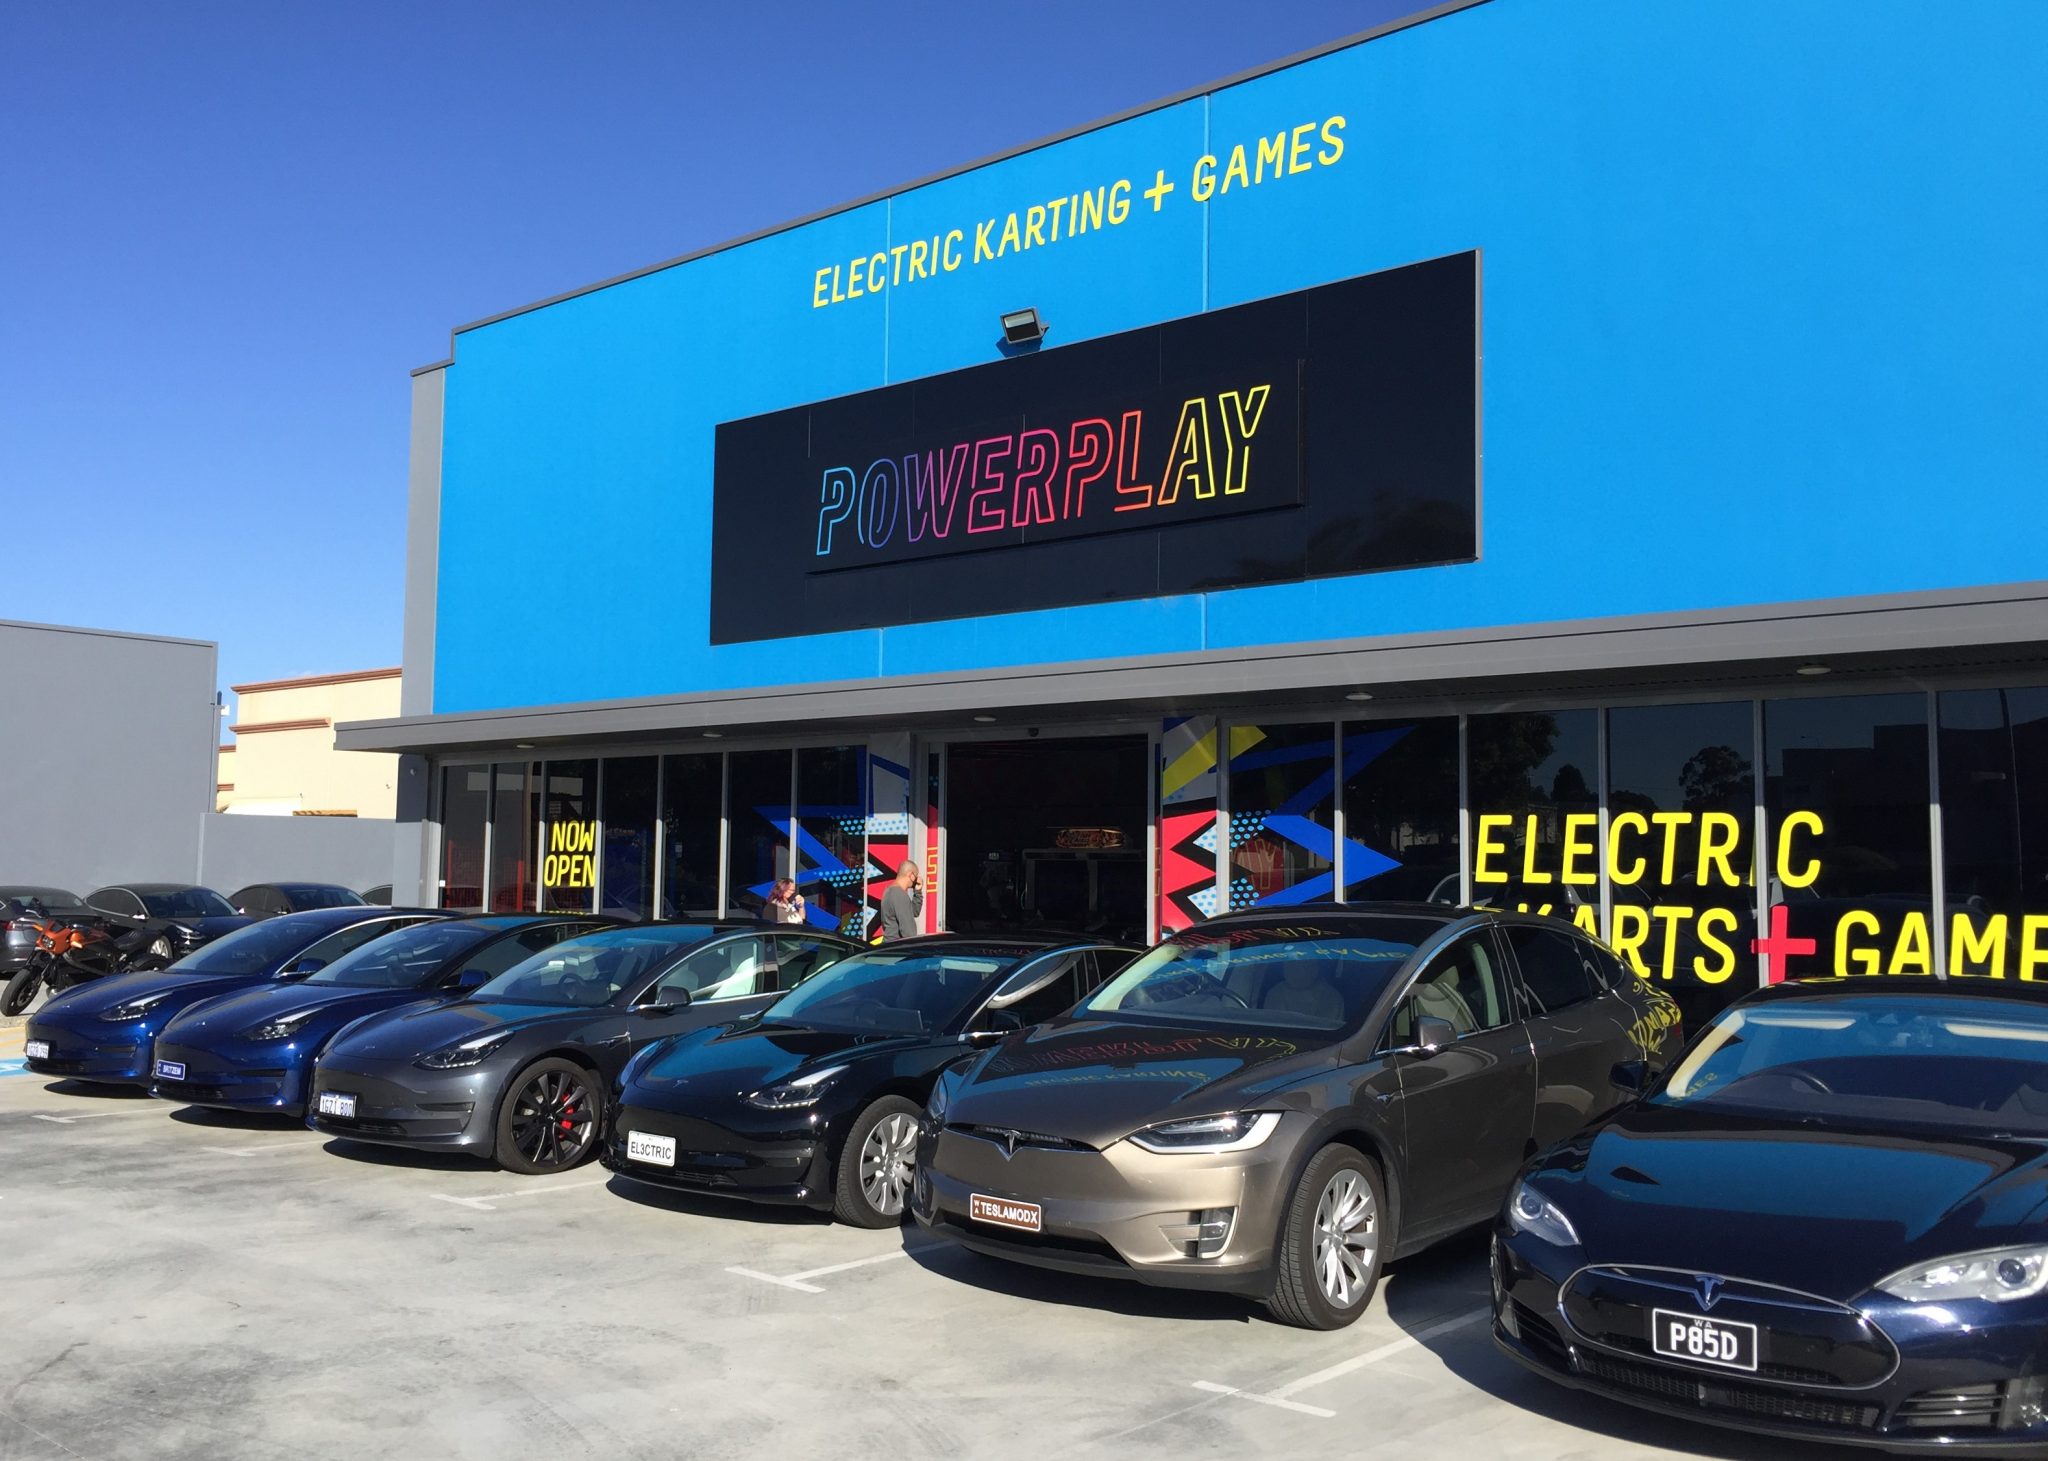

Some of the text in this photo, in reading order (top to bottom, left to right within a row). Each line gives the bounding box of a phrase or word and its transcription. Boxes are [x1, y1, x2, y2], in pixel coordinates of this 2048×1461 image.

[813, 115, 1346, 308] ELECTRIC KARTING + GAMES
[816, 384, 1271, 556] POWERPLAY
[551, 821, 595, 852] NOW
[543, 854, 597, 888] OPEN
[630, 1141, 672, 1160] EL3CTRIC
[980, 1201, 1038, 1225] TESLAMODX
[1694, 1318, 1713, 1329] WA
[1670, 1322, 1738, 1361] P85D
